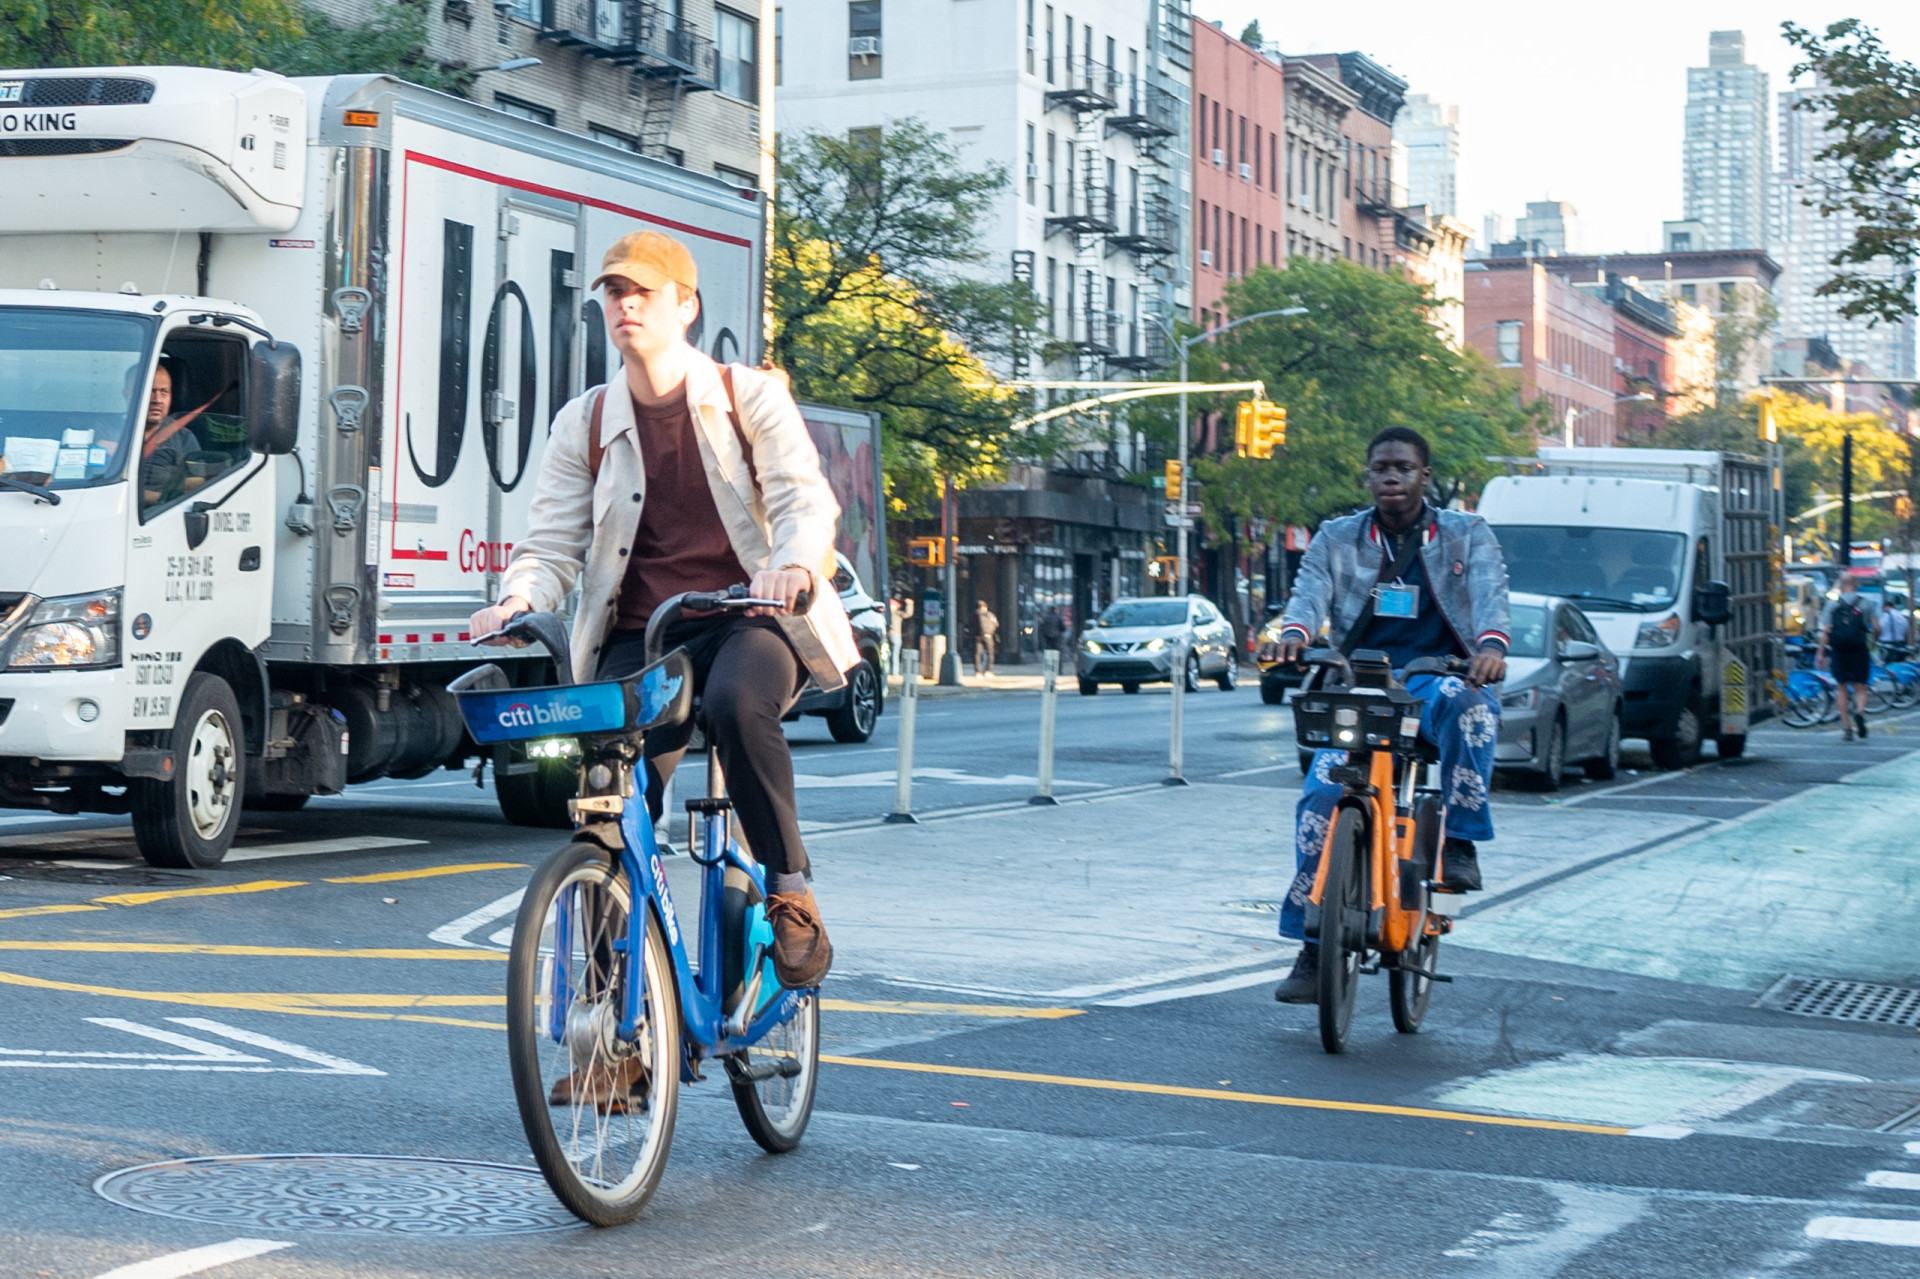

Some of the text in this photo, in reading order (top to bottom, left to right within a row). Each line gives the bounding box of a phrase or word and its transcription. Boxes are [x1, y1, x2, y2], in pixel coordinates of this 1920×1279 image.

[24, 112, 76, 131] KING
[131, 652, 162, 661] HINO
[499, 702, 583, 727] citi bike
[651, 854, 679, 946] citi bike
